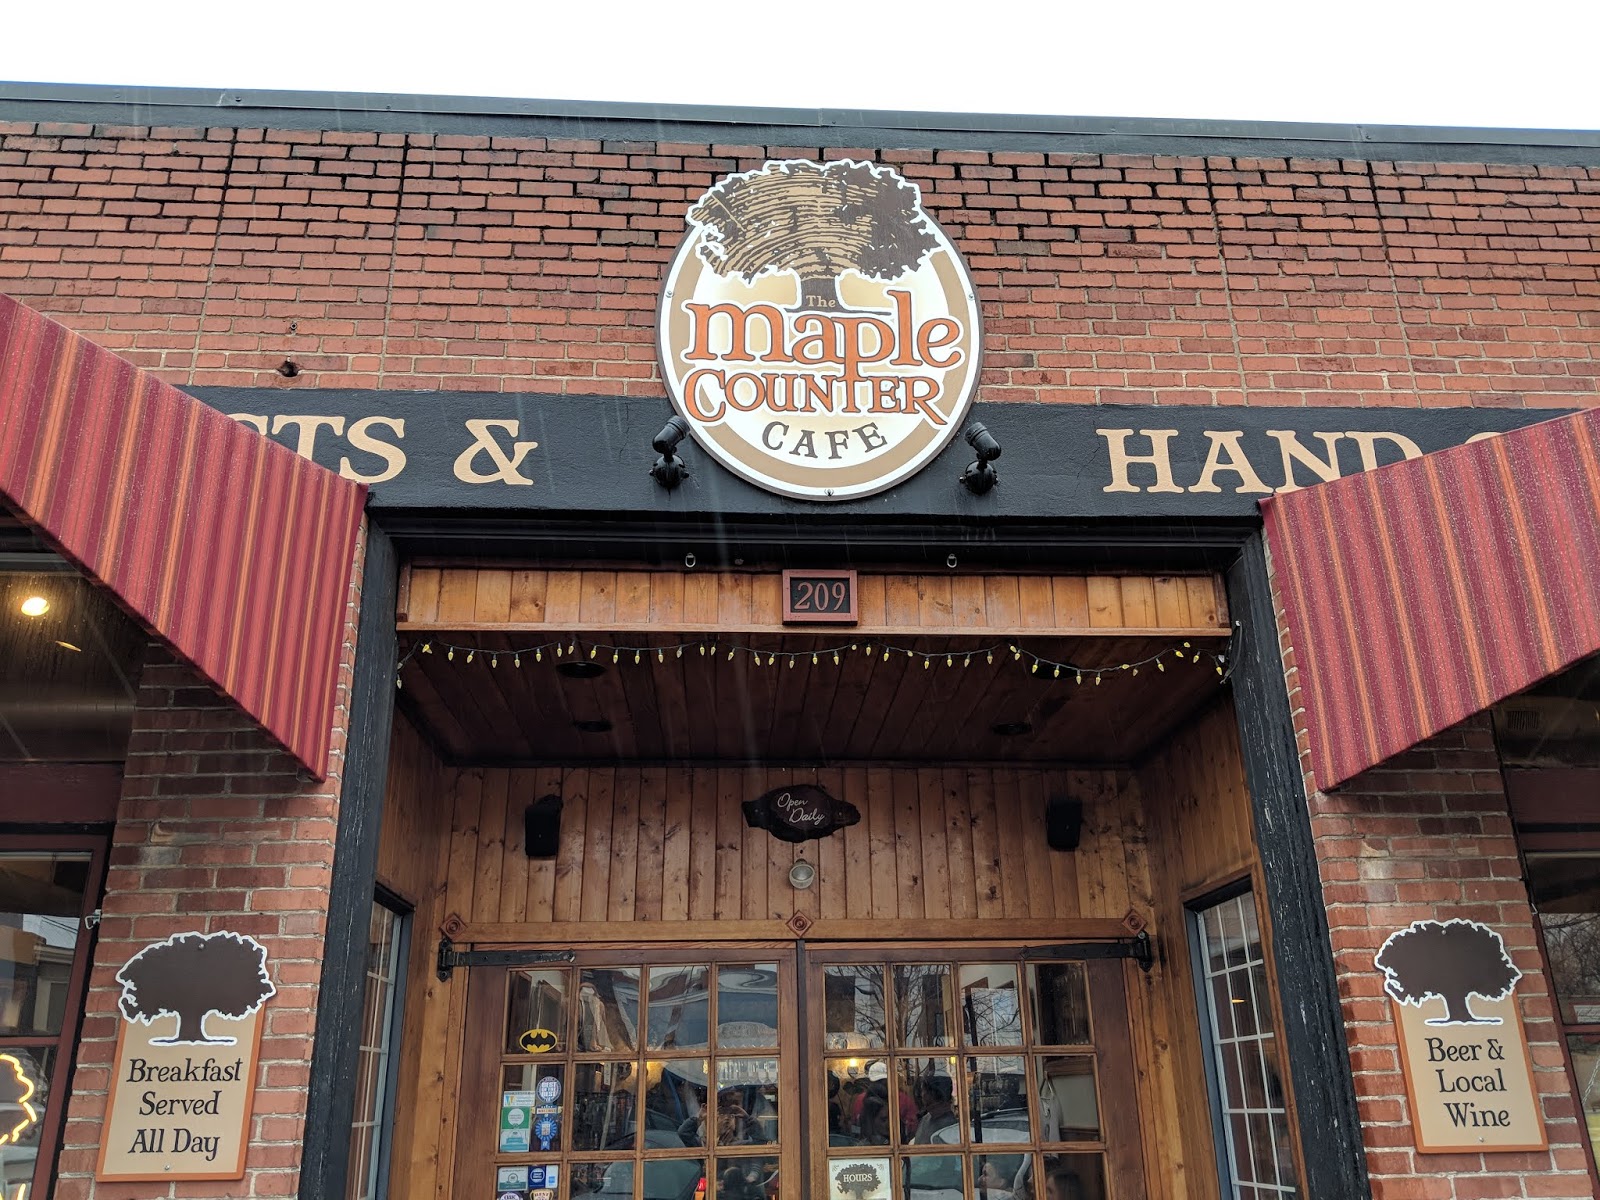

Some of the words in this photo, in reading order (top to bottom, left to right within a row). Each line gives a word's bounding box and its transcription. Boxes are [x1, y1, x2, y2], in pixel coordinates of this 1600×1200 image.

[805, 294, 836, 308] The
[685, 290, 962, 381] maple
[684, 369, 948, 425] COUNTER
[225, 413, 407, 484] TS
[453, 419, 539, 486] &
[761, 421, 888, 460] CAFE
[793, 581, 847, 611] 209
[777, 792, 809, 811] Open
[788, 807, 825, 825] Daily
[1424, 1037, 1483, 1062] Beer
[1487, 1038, 1505, 1061] &
[126, 1057, 243, 1083] Breakfast
[1434, 1068, 1507, 1094] Local
[138, 1090, 222, 1116] Served
[1443, 1102, 1511, 1128] Wine
[127, 1128, 165, 1154] All
[170, 1128, 221, 1161] Day
[843, 1173, 873, 1183] HOURS
